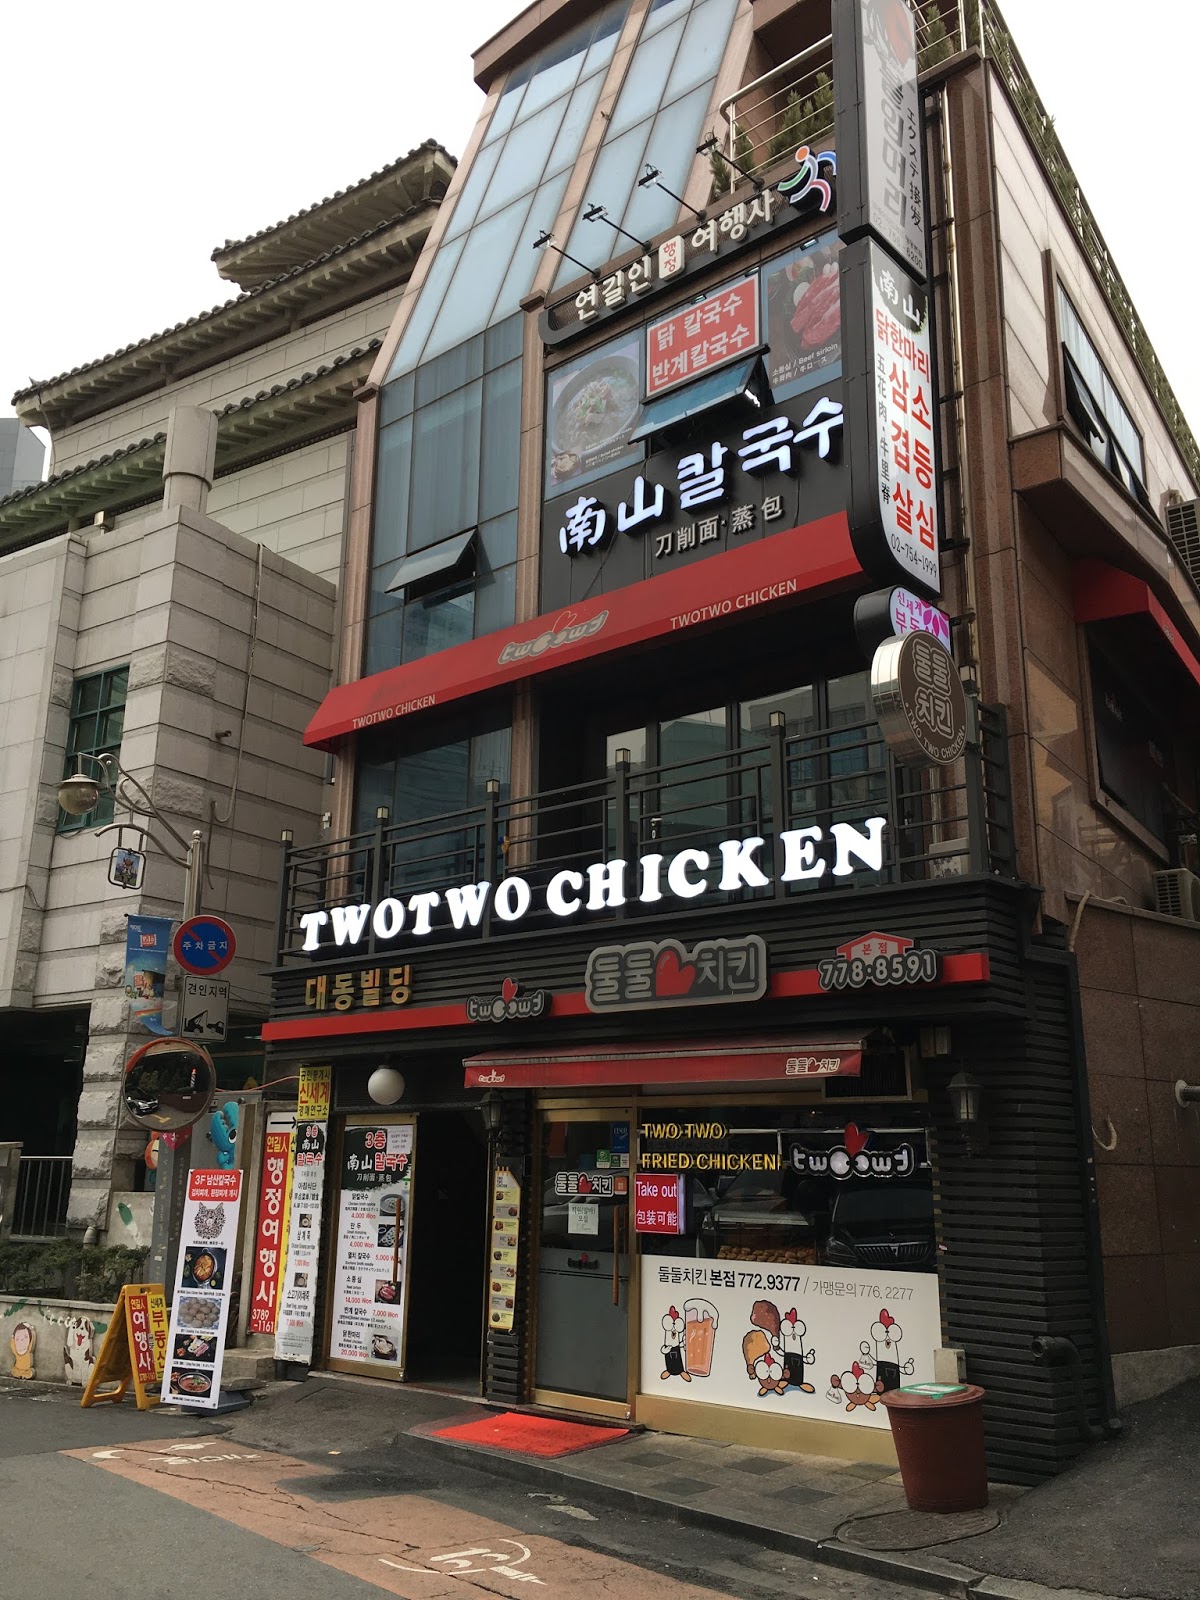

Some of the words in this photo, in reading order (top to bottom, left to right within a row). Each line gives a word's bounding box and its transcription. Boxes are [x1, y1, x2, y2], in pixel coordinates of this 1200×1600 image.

[575, 254, 652, 322] 연길인
[662, 239, 678, 273] 행정
[691, 188, 775, 253] 여행사
[879, 269, 920, 326] 南山
[656, 324, 676, 351] 닭
[683, 292, 743, 337] 칼국수
[652, 323, 750, 386] 반계칼국수
[798, 352, 814, 364] Beef
[816, 343, 838, 357] sirloin
[876, 308, 930, 383] 닭한마리
[889, 361, 914, 536] 삼겹살
[911, 385, 935, 552] 소등심
[890, 533, 937, 579] 02-754-1999
[670, 599, 732, 630] TWOTWO
[735, 578, 798, 610] CHICKEN
[896, 590, 923, 617] 신세계
[895, 607, 935, 635] 부동
[352, 707, 393, 729] TWOTWO
[395, 694, 436, 717] CHICKEN
[915, 690, 952, 738] 치킨
[907, 710, 922, 738] TWO
[923, 736, 940, 758] TWO
[940, 730, 964, 759] CHICKEN
[300, 876, 531, 951] TWOTWO
[546, 816, 888, 917] CHICKEN
[182, 940, 228, 950] 주차금지
[862, 942, 888, 955] 본점
[187, 982, 228, 998] 견인지역
[304, 964, 415, 1011] 대동빌딩
[299, 1082, 329, 1104] 신세계
[298, 1105, 328, 1116] 경매연구소
[301, 1138, 320, 1150] 南山
[365, 1130, 386, 1149] 3층
[642, 1123, 679, 1139] TWO
[685, 1123, 724, 1139] TWO
[296, 1152, 323, 1166] 칼국수
[642, 1153, 690, 1169] FRIED
[194, 1175, 206, 1185] 3F
[207, 1174, 237, 1187] 남산칼국수
[636, 1181, 658, 1197] Take
[661, 1183, 678, 1198] out
[636, 1209, 678, 1226] 包装可能
[256, 1156, 284, 1308] 행정여행사
[709, 1269, 735, 1288] 본점
[737, 1271, 801, 1292] 772.9377
[812, 1280, 857, 1297] 가맹문의
[858, 1284, 914, 1301] 776.2277
[252, 1308, 270, 1321] 3789
[372, 1309, 387, 1317] 7,000
[132, 1311, 153, 1371] 여행사
[340, 1348, 357, 1357] 20,000
